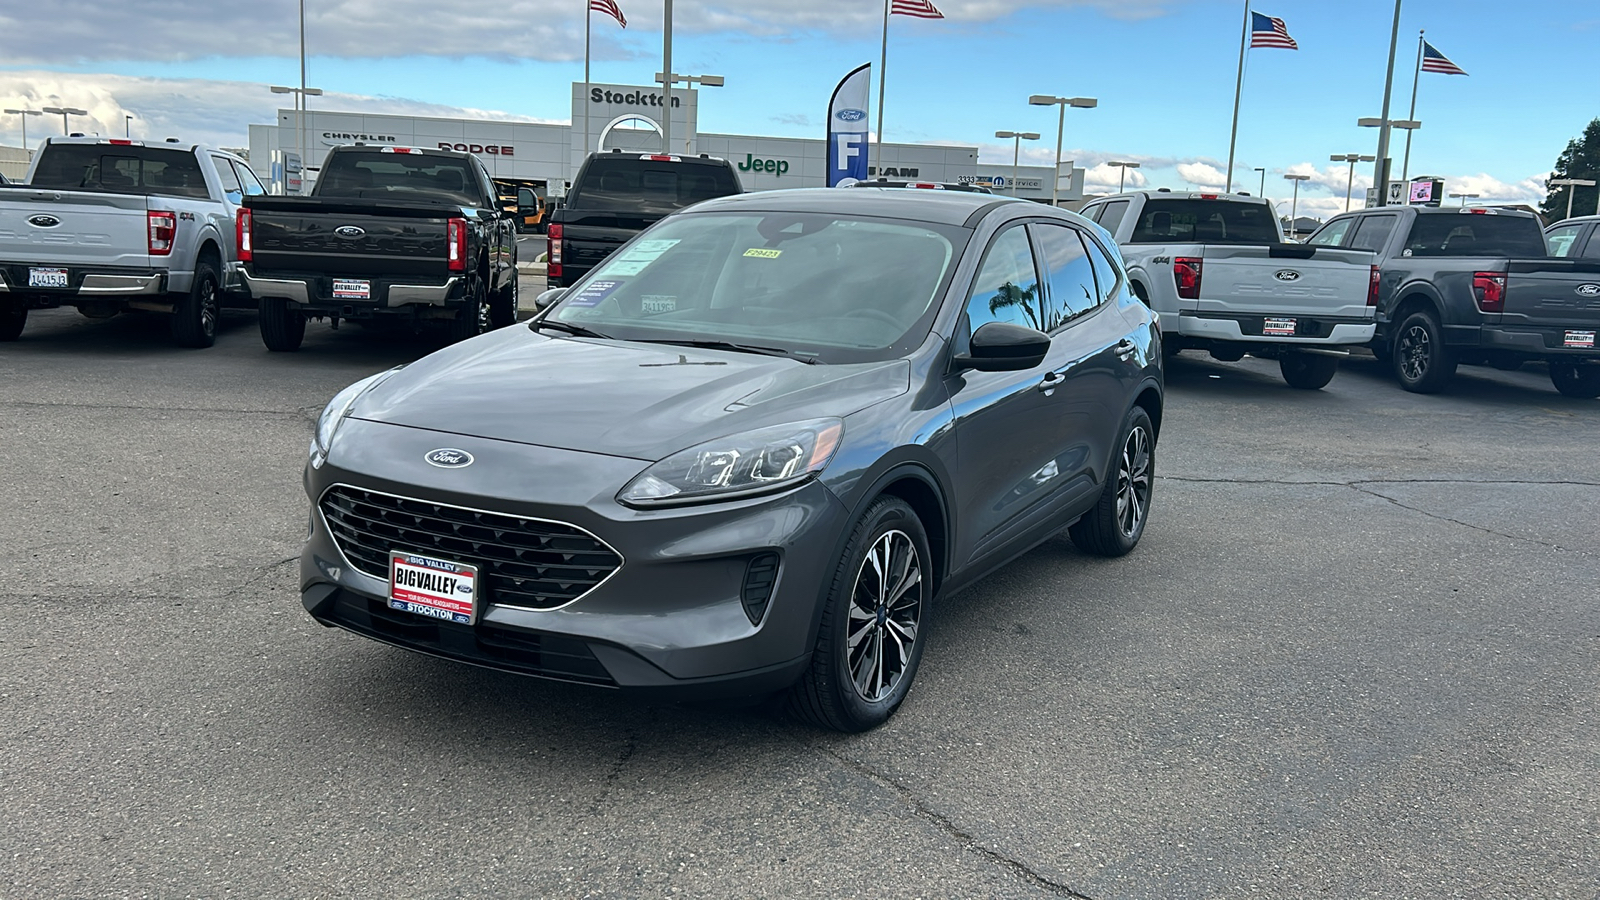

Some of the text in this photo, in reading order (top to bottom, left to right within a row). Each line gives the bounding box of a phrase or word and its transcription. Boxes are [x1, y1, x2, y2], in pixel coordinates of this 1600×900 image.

[591, 88, 680, 108] Stockton
[323, 132, 396, 142] CHRYSLER
[438, 143, 514, 156] DODGE
[738, 153, 789, 177] Jeep
[868, 166, 919, 178] RAM
[1008, 179, 1039, 187] Srvice
[745, 249, 779, 258] F29423
[410, 556, 455, 571] BIG VALLEY
[396, 567, 458, 595] BIGVALLEY
[407, 603, 453, 620] STOCKTON
